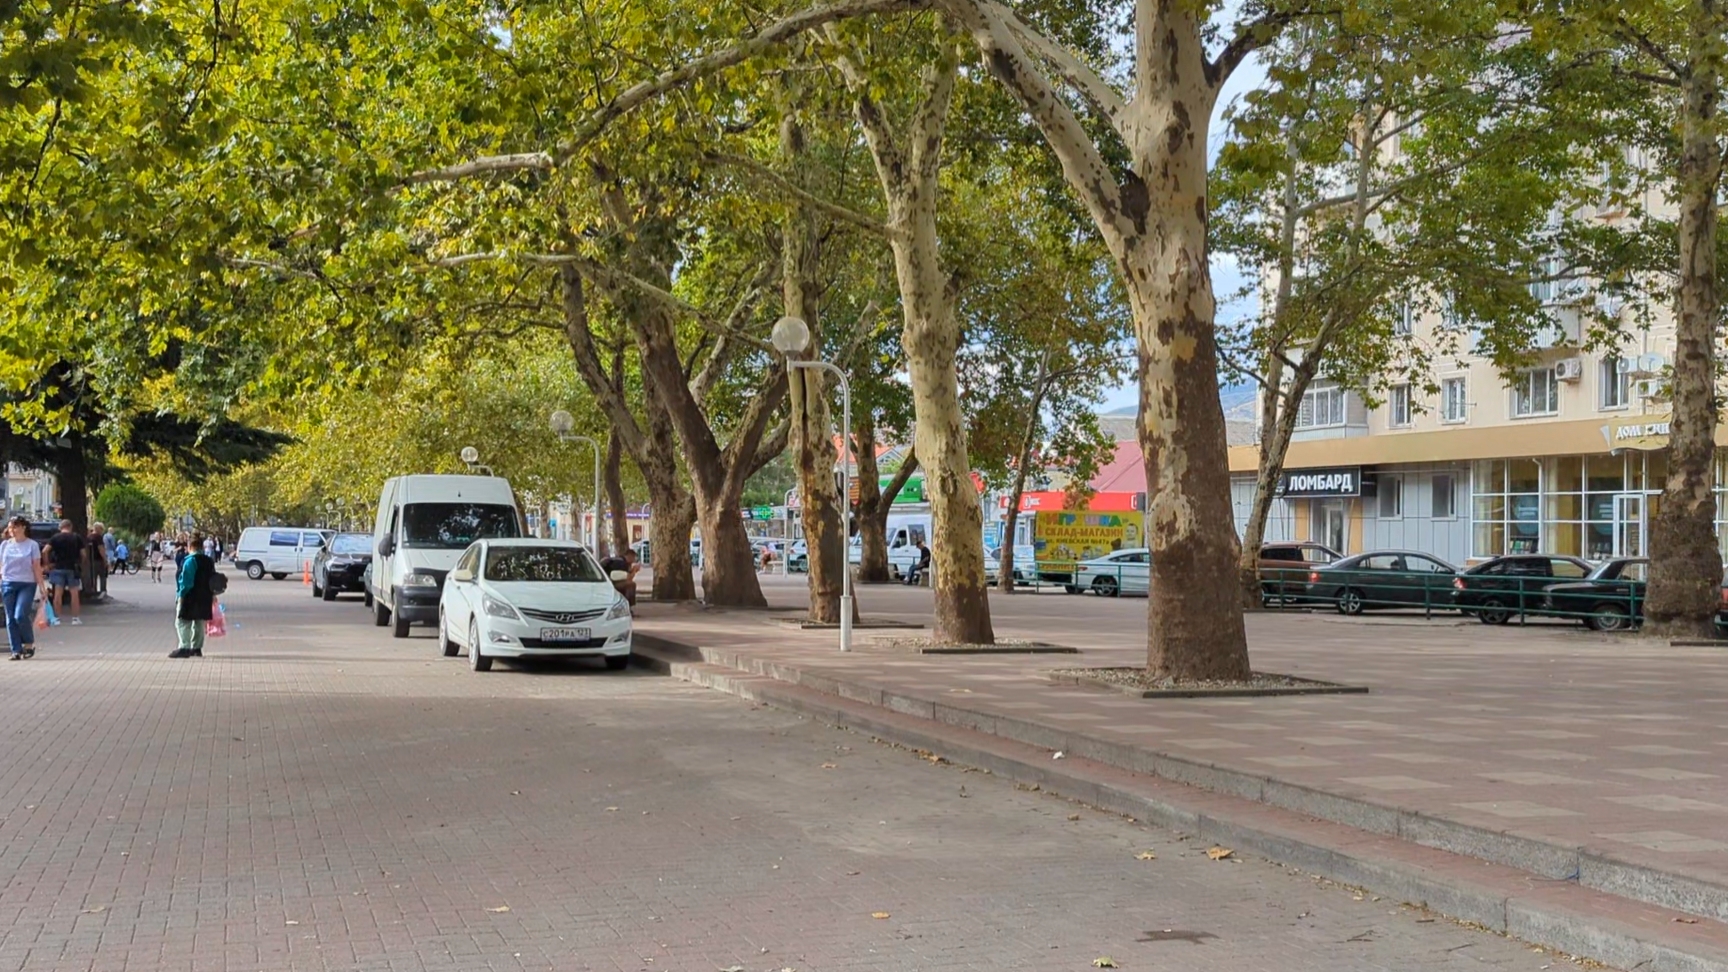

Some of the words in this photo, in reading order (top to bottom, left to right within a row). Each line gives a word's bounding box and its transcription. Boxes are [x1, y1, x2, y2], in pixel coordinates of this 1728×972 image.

[1616, 425, 1642, 440] ДОМ
[1644, 422, 1670, 436] КНИ
[1288, 473, 1353, 492] ЛОМБАРД
[1045, 527, 1123, 538] СКЛАД-МАГАЗИН
